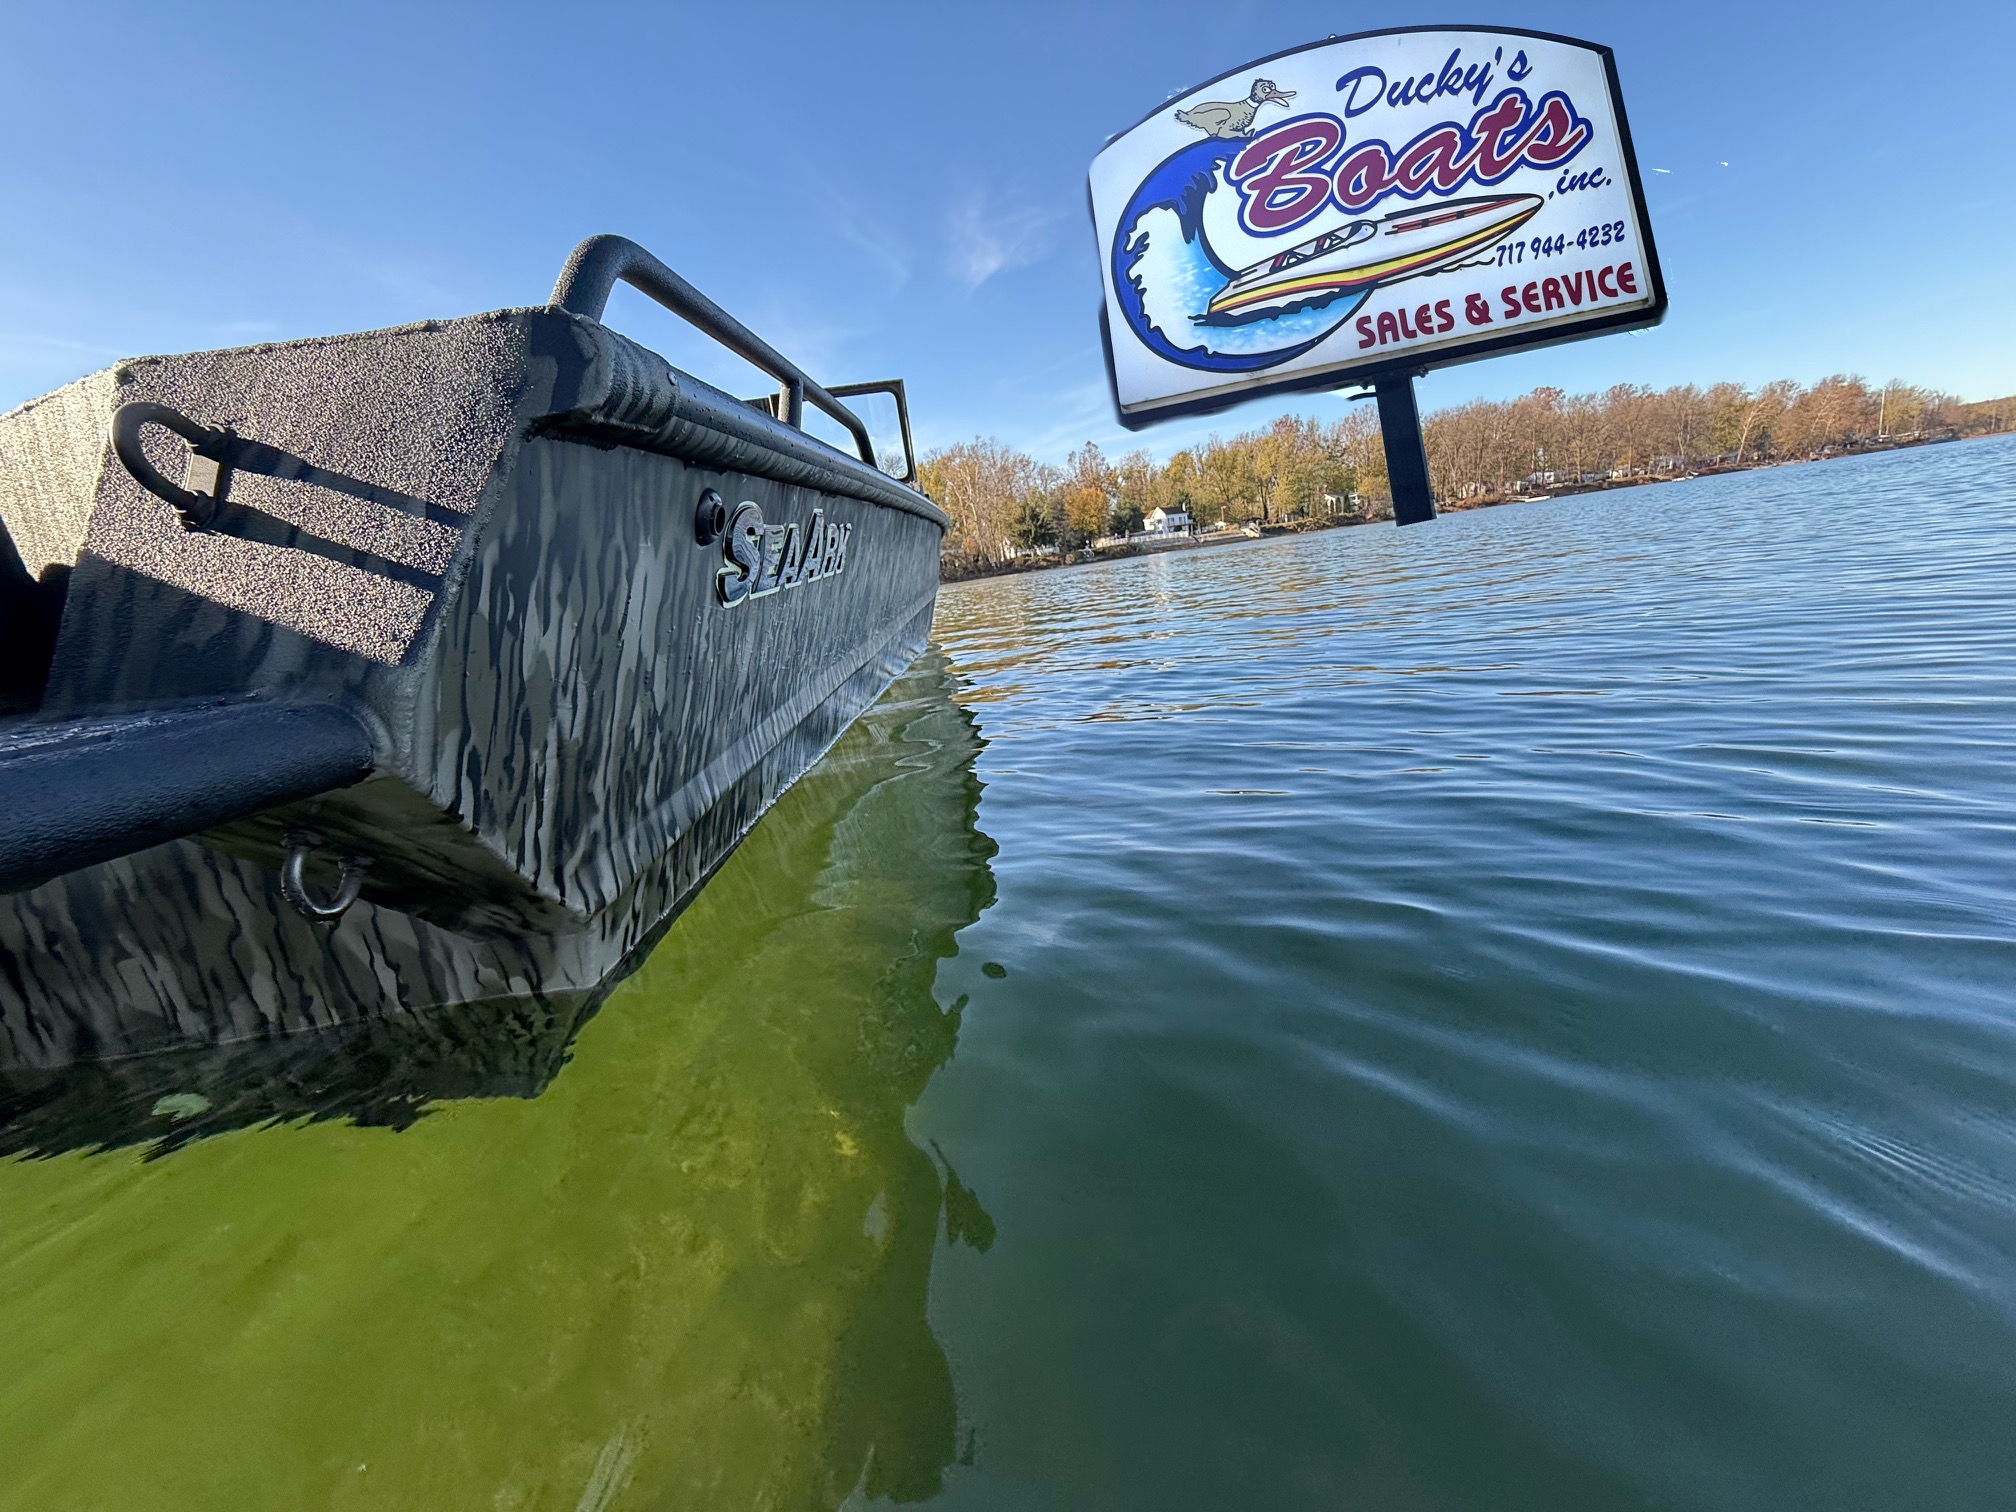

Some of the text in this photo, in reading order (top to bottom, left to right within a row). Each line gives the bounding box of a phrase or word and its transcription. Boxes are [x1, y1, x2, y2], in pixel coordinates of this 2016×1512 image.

[1336, 46, 1533, 118] Ducky's
[1225, 88, 1593, 236] Boats
[1496, 220, 1625, 267] 717 944-4232
[1356, 262, 1637, 349] SALES & SERVICE
